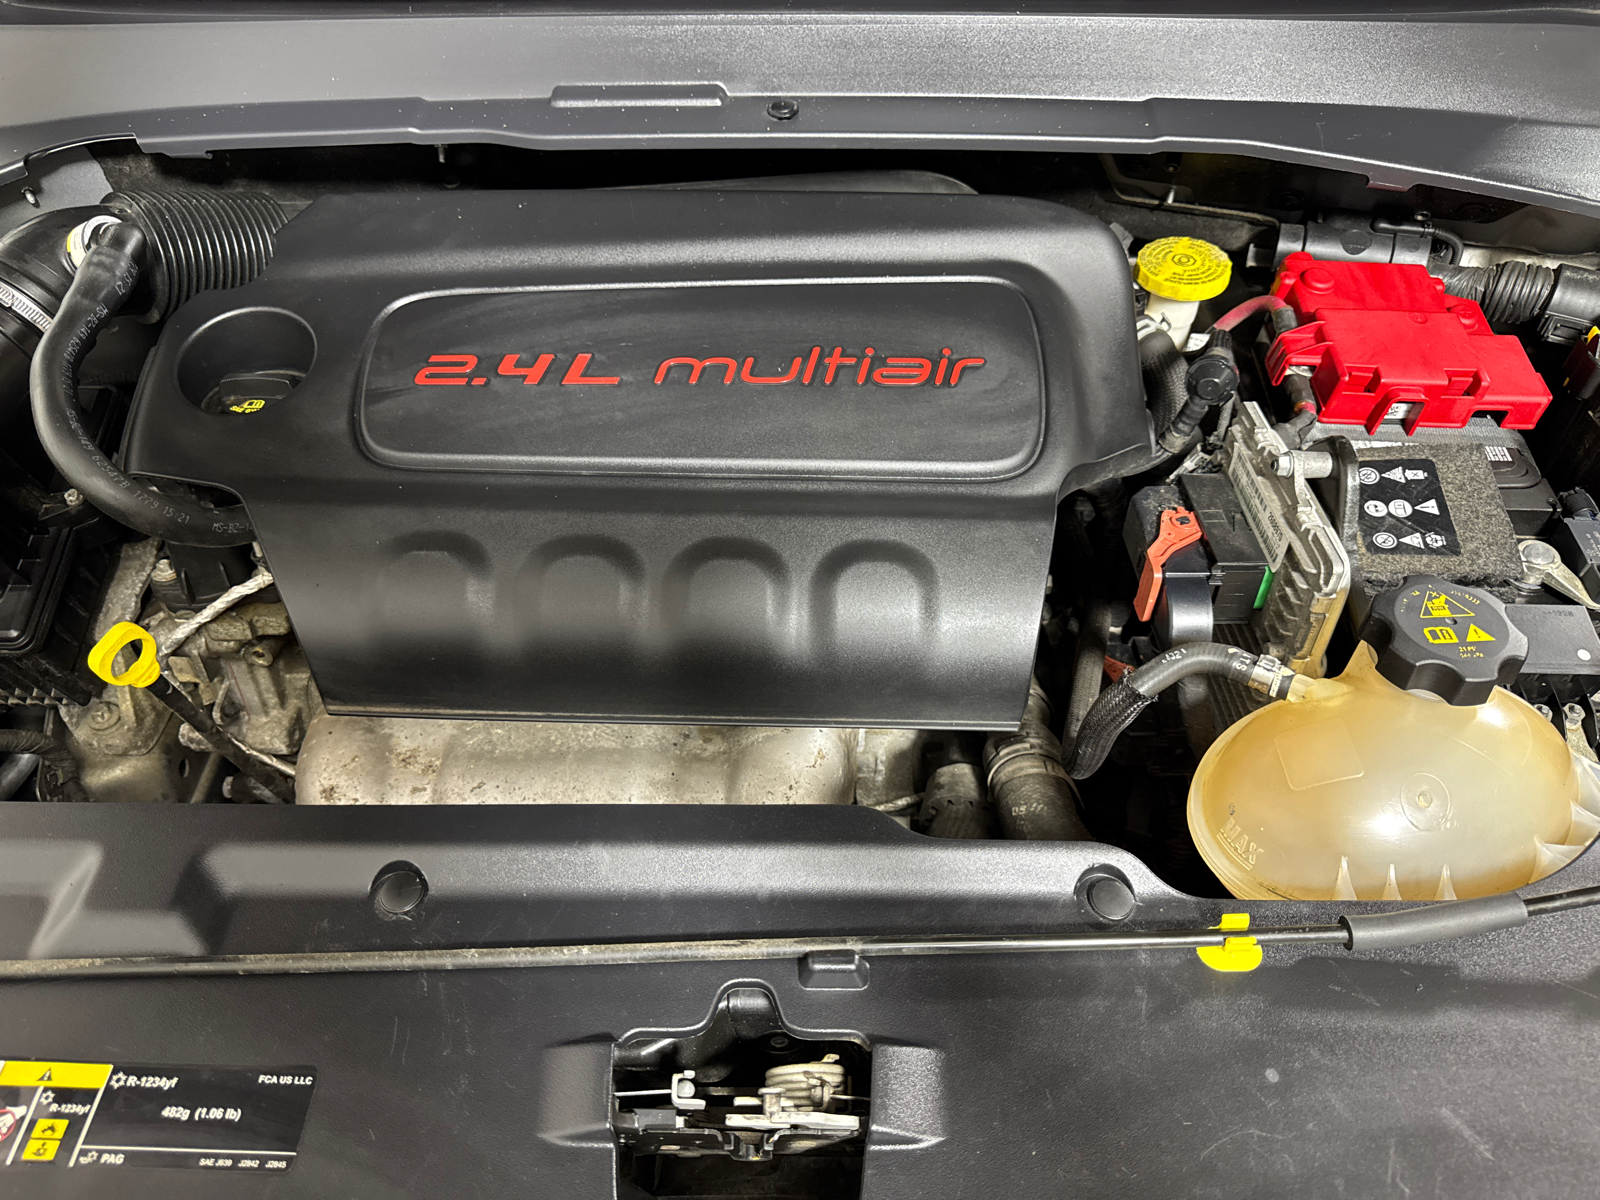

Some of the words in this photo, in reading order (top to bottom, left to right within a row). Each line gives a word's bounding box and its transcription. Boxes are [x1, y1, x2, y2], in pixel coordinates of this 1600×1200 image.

[653, 346, 986, 386] multiair
[133, 490, 160, 509] 1779
[1219, 817, 1265, 866] MAX
[126, 1075, 179, 1091] R-1234yf
[258, 1074, 278, 1084] FCA
[279, 1075, 293, 1085] US
[294, 1076, 313, 1086] LLC
[49, 1102, 92, 1116] R-1234yf
[160, 1105, 191, 1121] 482g
[193, 1106, 225, 1122] (1.06
[224, 1107, 243, 1123] lb)
[100, 1153, 126, 1165] PAG
[198, 1157, 215, 1167] SAE
